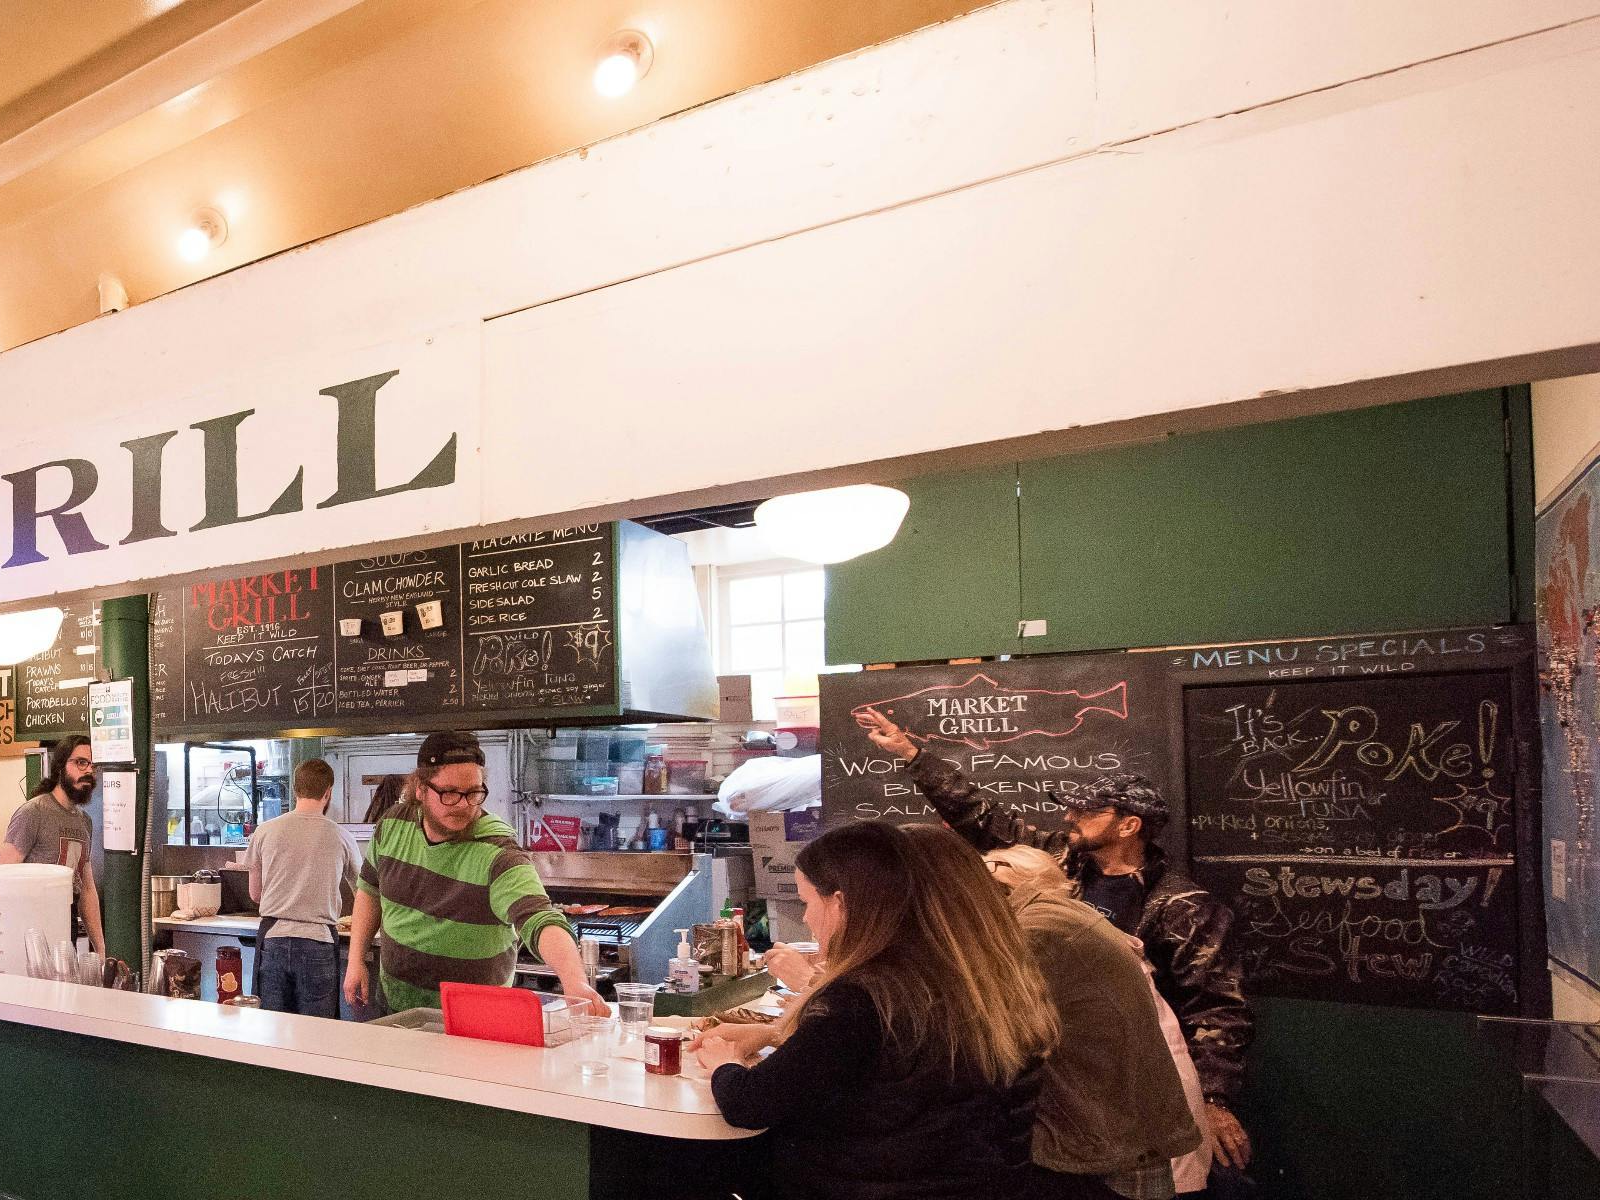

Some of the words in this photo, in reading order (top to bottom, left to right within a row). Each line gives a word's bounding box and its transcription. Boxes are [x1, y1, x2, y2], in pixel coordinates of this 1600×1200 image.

[472, 540, 480, 551] A
[468, 564, 509, 578] GARLIC
[513, 558, 554, 572] BREAD
[591, 551, 604, 566] 2
[343, 580, 382, 597] CLAM
[384, 571, 446, 593] CHOWDER
[469, 581, 501, 595] FRESH
[502, 580, 519, 591] CUT
[521, 577, 546, 588] COLE
[549, 573, 582, 585] SLAW
[591, 571, 603, 583] 2
[469, 597, 495, 610] SIDE
[496, 595, 535, 607] SALAD
[591, 586, 602, 600] 5
[208, 593, 310, 631] GRILL
[469, 614, 497, 626] SIDE
[499, 612, 528, 623] RICE
[592, 607, 603, 620] 2
[217, 633, 244, 645] KEEP
[253, 631, 264, 640] IT
[270, 628, 297, 639] WILD
[204, 647, 264, 666] TODAY'S
[273, 646, 318, 661] CATCH
[368, 645, 425, 660] DRINKS
[1192, 647, 1300, 669] MENU
[1315, 633, 1485, 663] SPECIALS
[26, 664, 62, 678] PRAWNS
[449, 668, 457, 678] 2
[1268, 667, 1315, 679] KEEP
[1331, 665, 1350, 676] IT
[1360, 662, 1415, 674] WILD
[191, 681, 282, 714] HALIBUT
[293, 690, 311, 714] 15
[373, 688, 400, 697] WATER
[26, 697, 78, 711] PORTOBELLO
[375, 699, 405, 708] PERRIER
[927, 695, 1028, 717] MARKET
[26, 712, 65, 727] CHICKEN
[939, 716, 1019, 735] GRILL
[840, 756, 962, 777] WOD
[971, 753, 1121, 773] FAMOUS
[884, 780, 1080, 797] BLKENED
[854, 803, 937, 820] SALM
[1242, 866, 1502, 910] Stewsday!
[1242, 896, 1455, 951] Seafood
[1268, 936, 1434, 983] Stew
